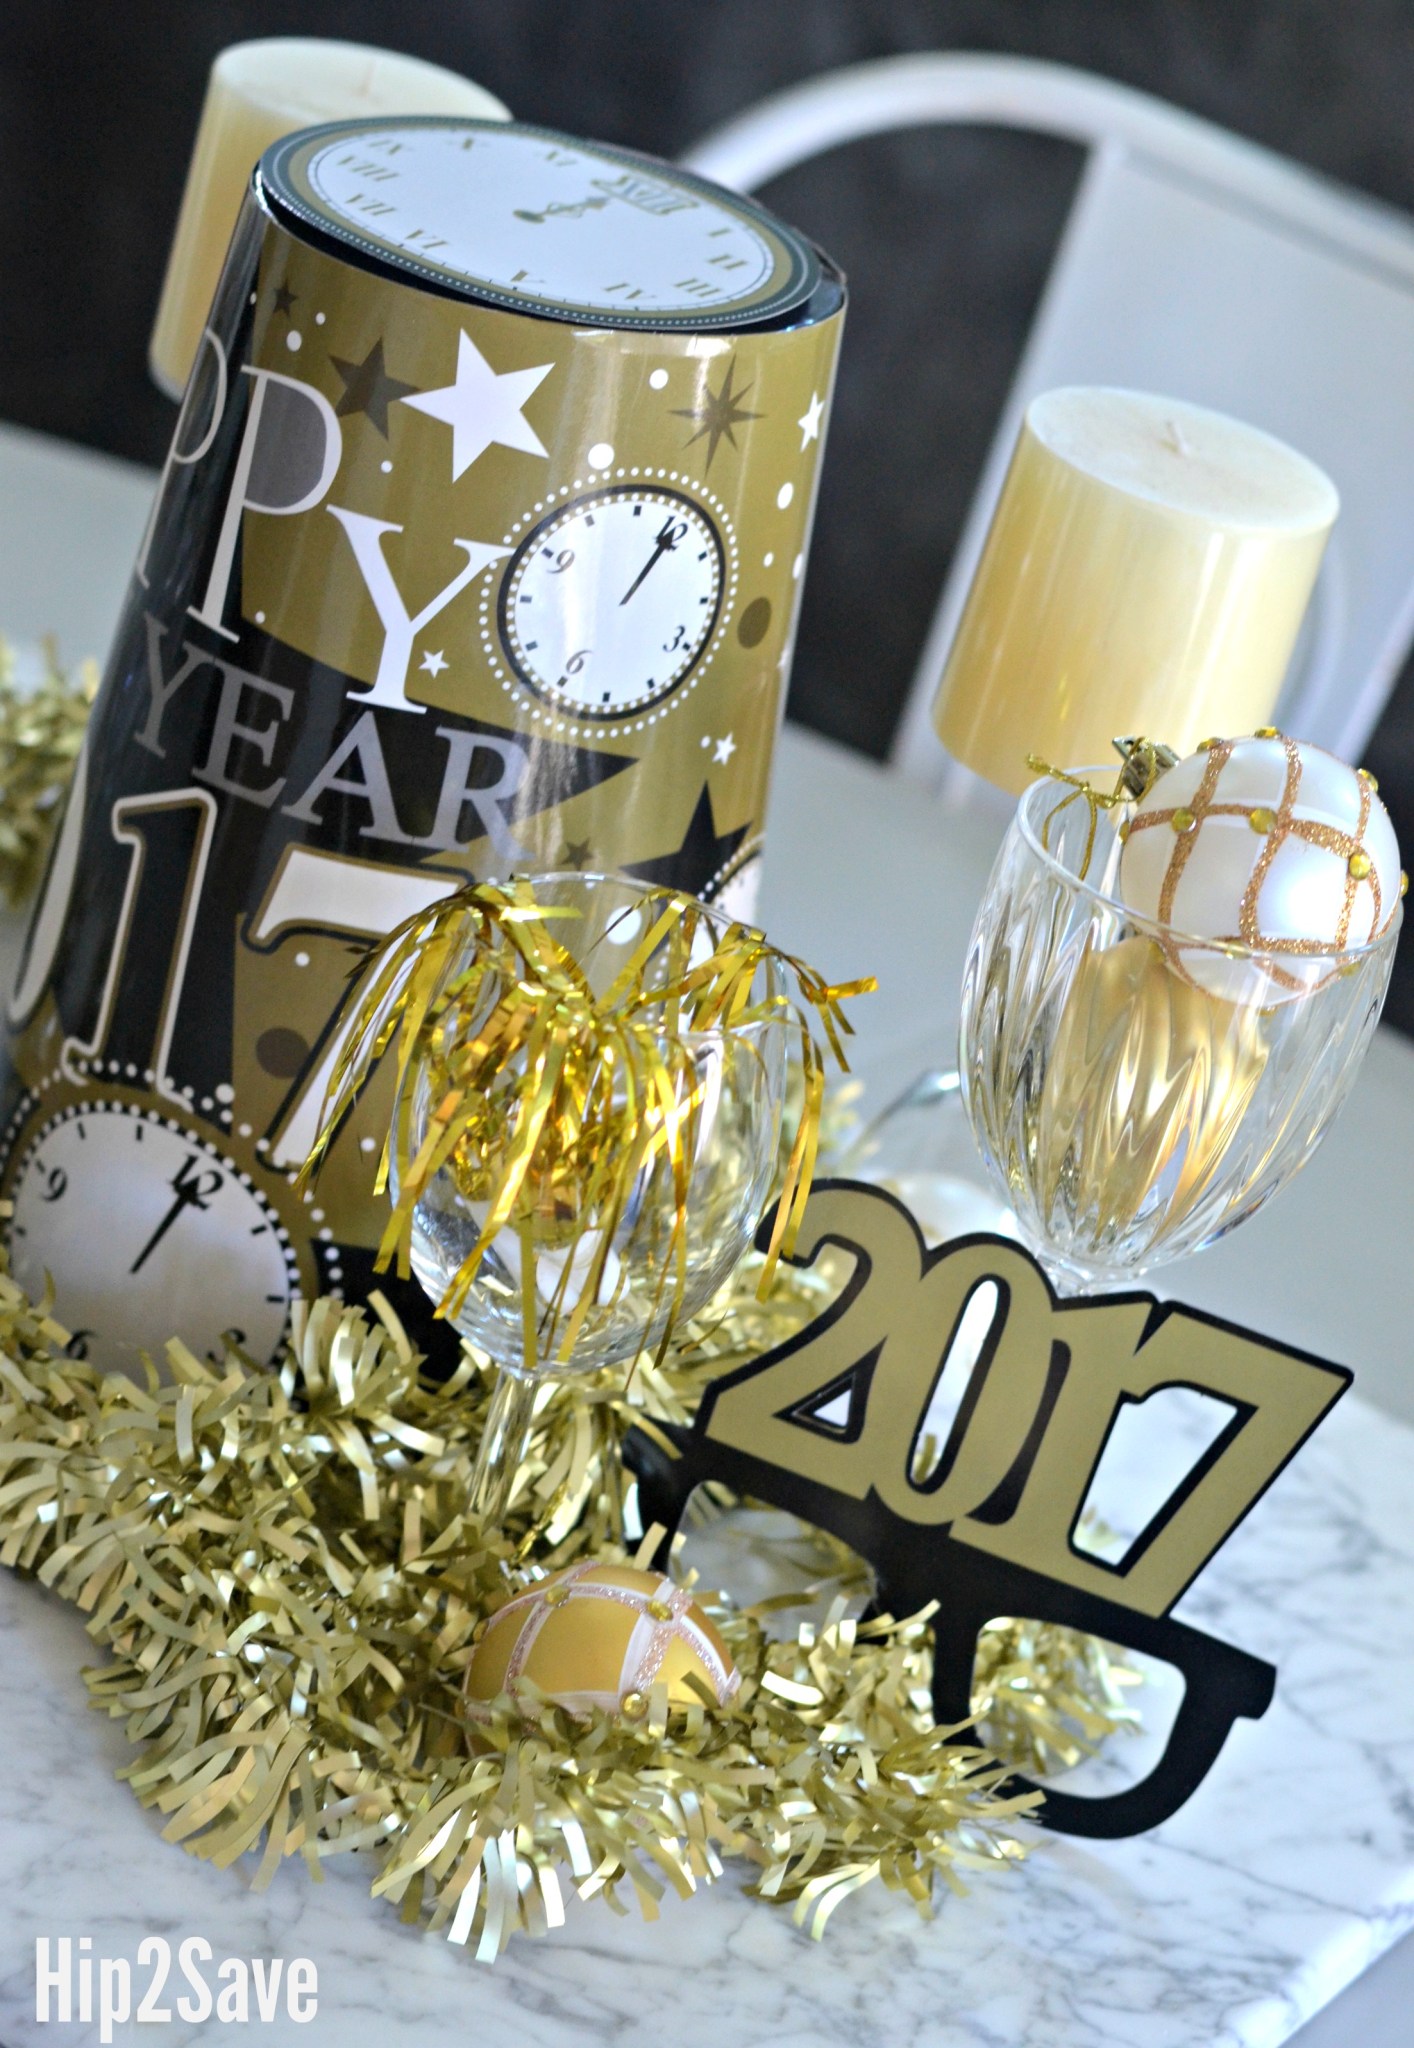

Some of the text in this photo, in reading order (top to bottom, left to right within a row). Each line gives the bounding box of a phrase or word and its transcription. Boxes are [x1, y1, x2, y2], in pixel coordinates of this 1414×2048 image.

[546, 549, 575, 575] 9
[663, 625, 686, 653] 3
[564, 650, 595, 675] 6
[133, 611, 537, 863] YEAR
[8, 738, 476, 1176] 17
[41, 1166, 68, 1203] 9
[698, 1178, 1354, 1620] 2017
